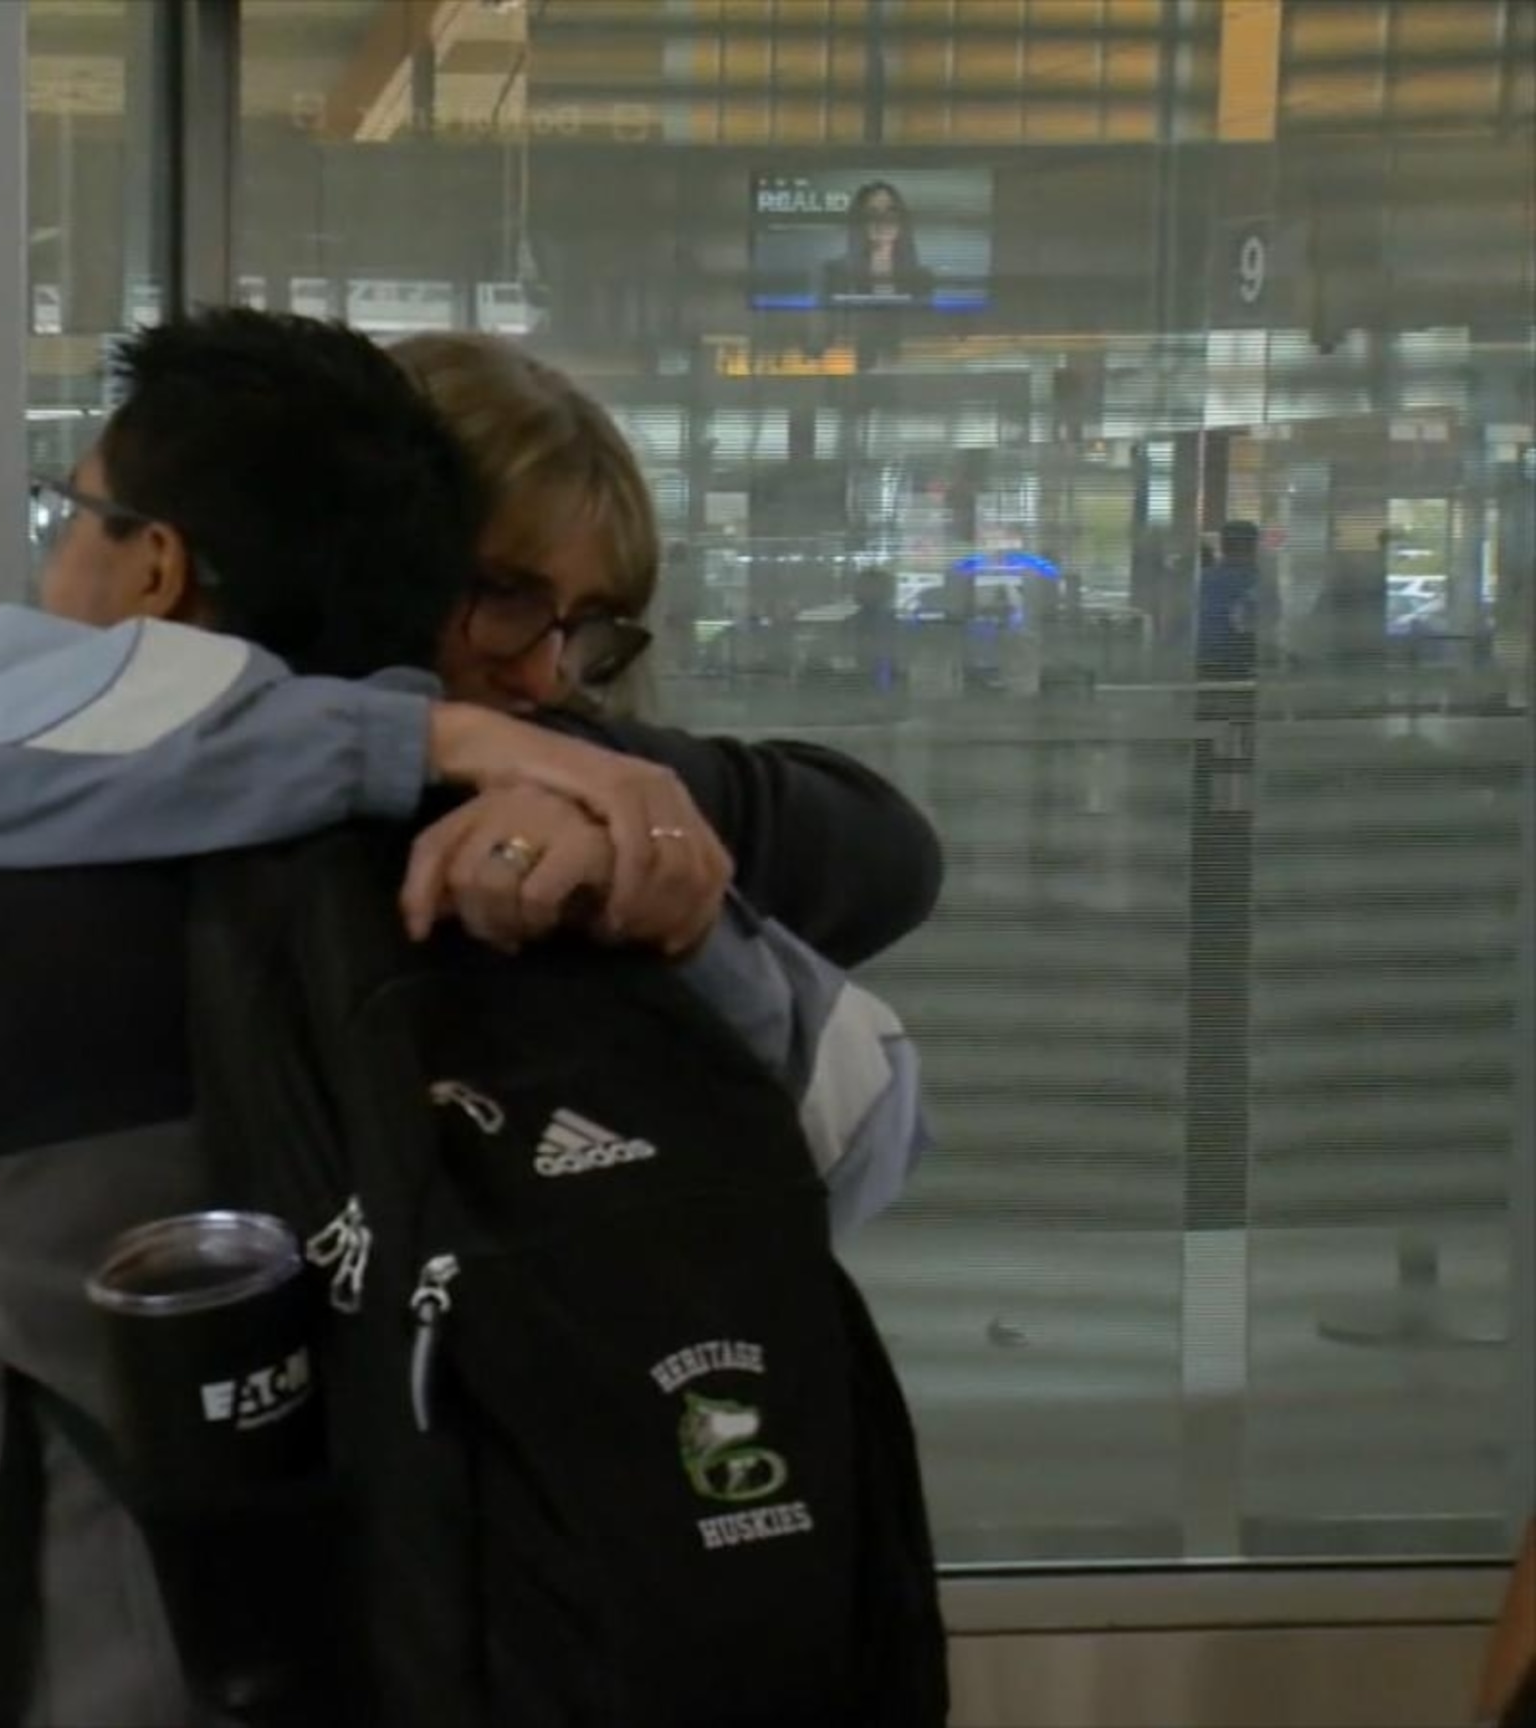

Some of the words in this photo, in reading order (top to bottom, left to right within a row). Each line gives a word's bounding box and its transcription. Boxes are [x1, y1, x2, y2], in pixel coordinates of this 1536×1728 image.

[757, 190, 822, 213] REAL
[825, 191, 852, 213] ID
[1239, 236, 1264, 302] 9
[533, 1137, 656, 1178] adidas
[200, 1346, 310, 1423] EATON
[649, 1340, 766, 1394] HERITAGE
[697, 1500, 813, 1549] HUSKIES
